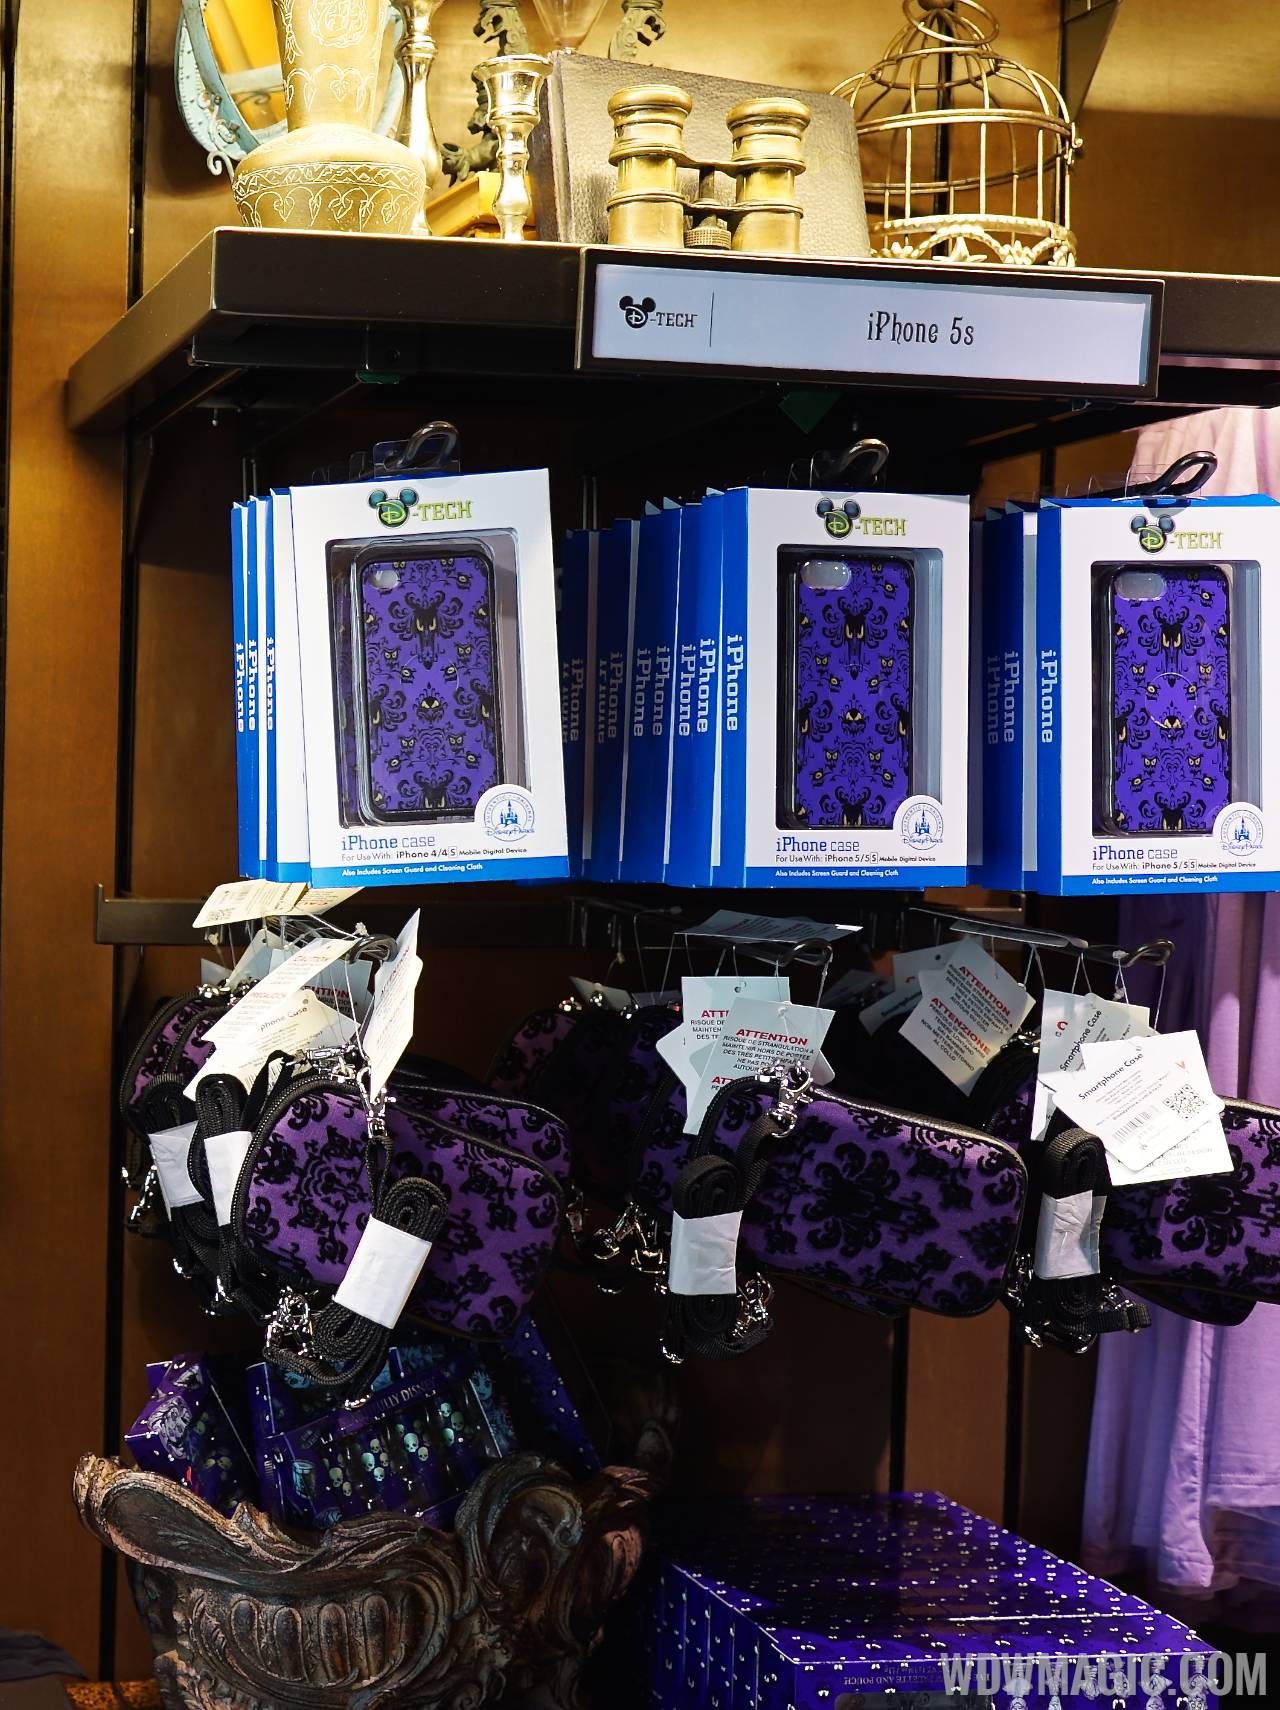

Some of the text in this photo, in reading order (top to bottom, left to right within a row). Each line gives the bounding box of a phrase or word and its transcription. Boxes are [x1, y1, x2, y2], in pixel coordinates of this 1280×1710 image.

[867, 311, 974, 345] iPhone 5s
[634, 648, 651, 737] iPhone
[652, 646, 670, 735] iPhone
[679, 644, 696, 736] iPhone
[697, 639, 715, 732] iPhone
[726, 635, 743, 731] iPhone
[1004, 651, 1020, 742] iPhone
[1041, 650, 1058, 743] iPhone
[342, 835, 435, 850] iPhone case
[357, 853, 371, 861] Use
[396, 850, 429, 859] iPhone
[459, 848, 481, 856] Mobile
[483, 847, 504, 856] Digital
[776, 837, 859, 851] iPhone case
[825, 854, 853, 862] iPhone
[1093, 845, 1178, 860] iPhone case
[342, 869, 356, 877] Also
[383, 866, 403, 874] Screen
[404, 865, 424, 873] Guard
[438, 864, 465, 872] Cleaning
[1142, 861, 1172, 869] iPhone
[1179, 876, 1202, 884] Cleaning
[958, 965, 1011, 1015] ATTENTION
[723, 1035, 746, 1044] RISQUE
[736, 1028, 808, 1046] ATTENTION
[931, 997, 991, 1054] ATTENZIONE
[1059, 1027, 1091, 1072] Smartphone
[1087, 1010, 1102, 1028] Case
[757, 1047, 775, 1055] HORS
[1079, 1066, 1125, 1100] Smartphone
[1124, 1053, 1144, 1068] Case
